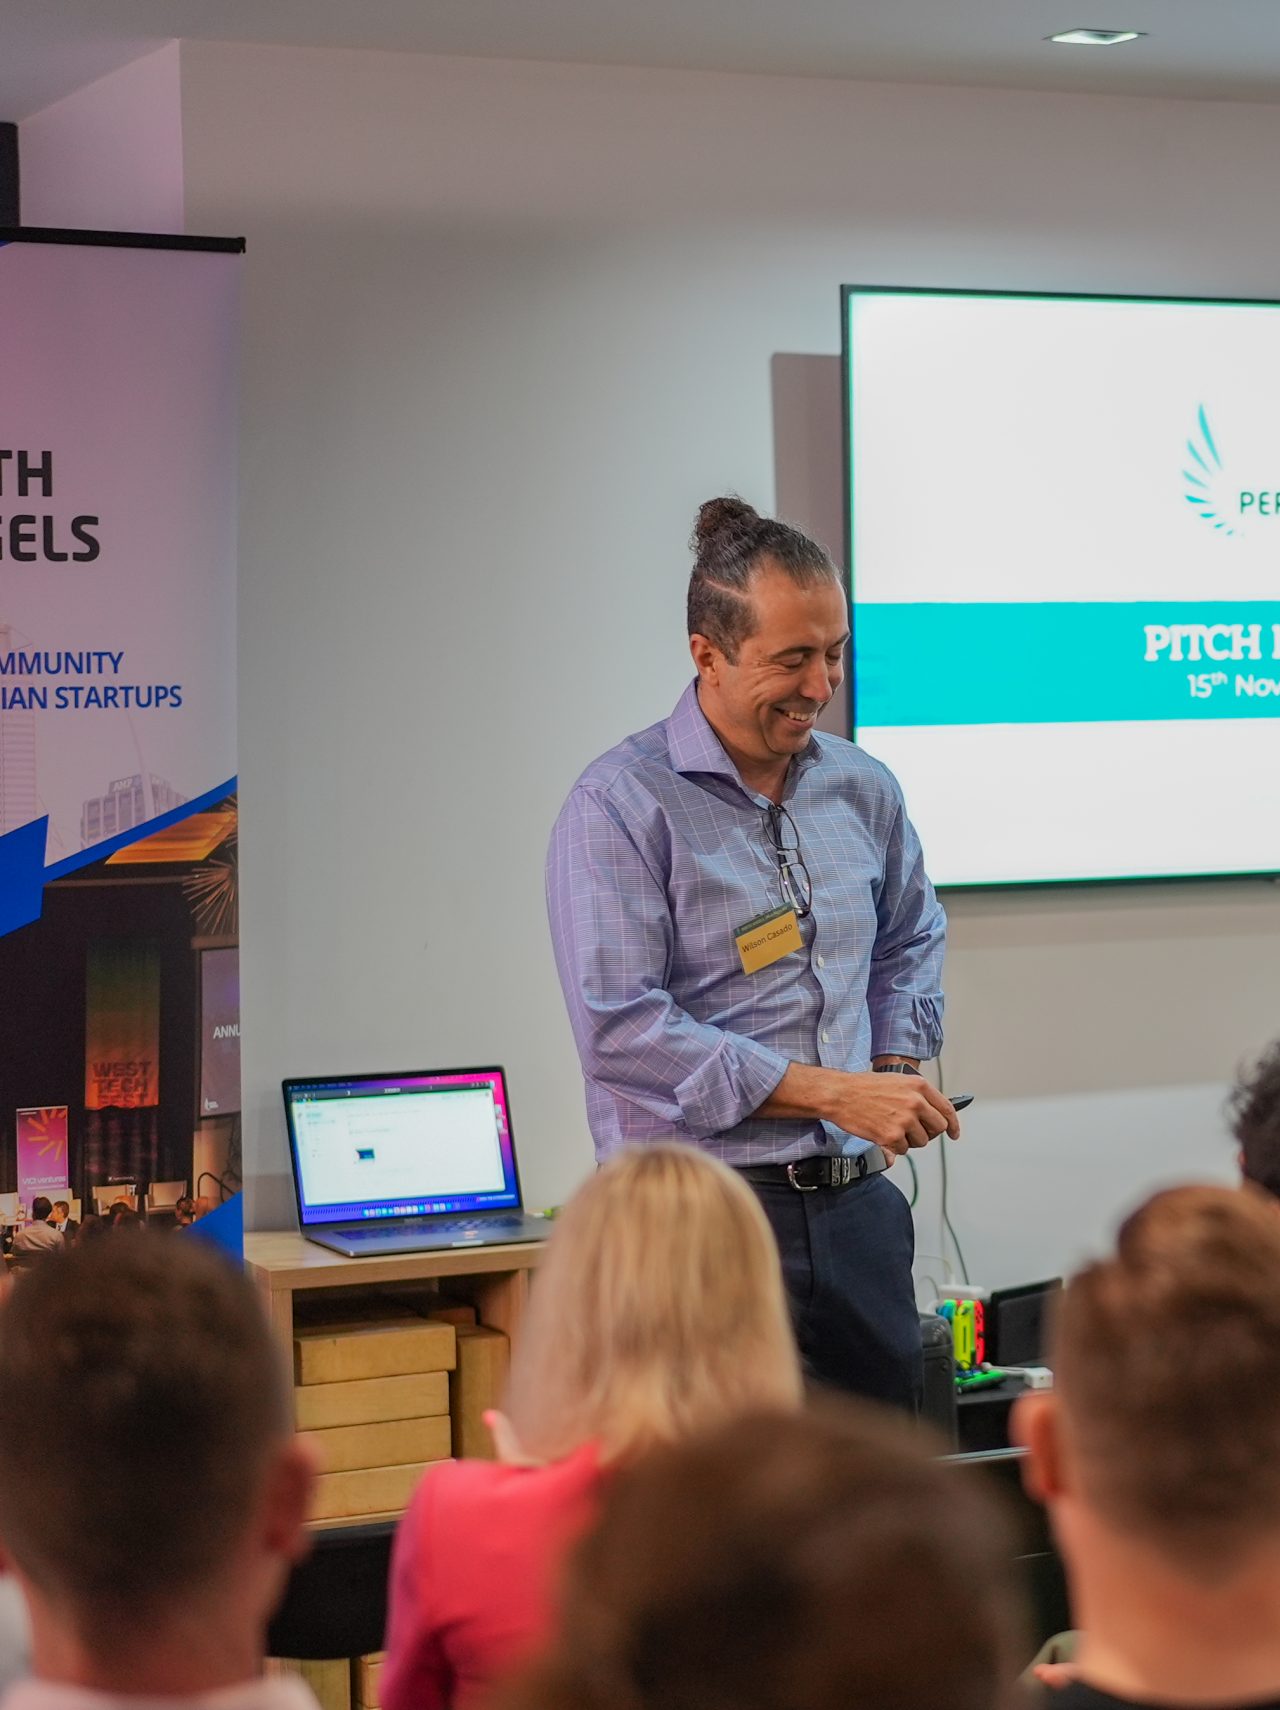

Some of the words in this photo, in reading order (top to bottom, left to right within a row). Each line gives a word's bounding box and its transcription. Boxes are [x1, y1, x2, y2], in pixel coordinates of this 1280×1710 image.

[0, 514, 100, 562] ELS
[1143, 623, 1263, 662] PITCH
[55, 685, 183, 709] STARTUPS
[742, 937, 766, 952] Wilson
[767, 924, 793, 941] Casado
[93, 1062, 151, 1077] WEST
